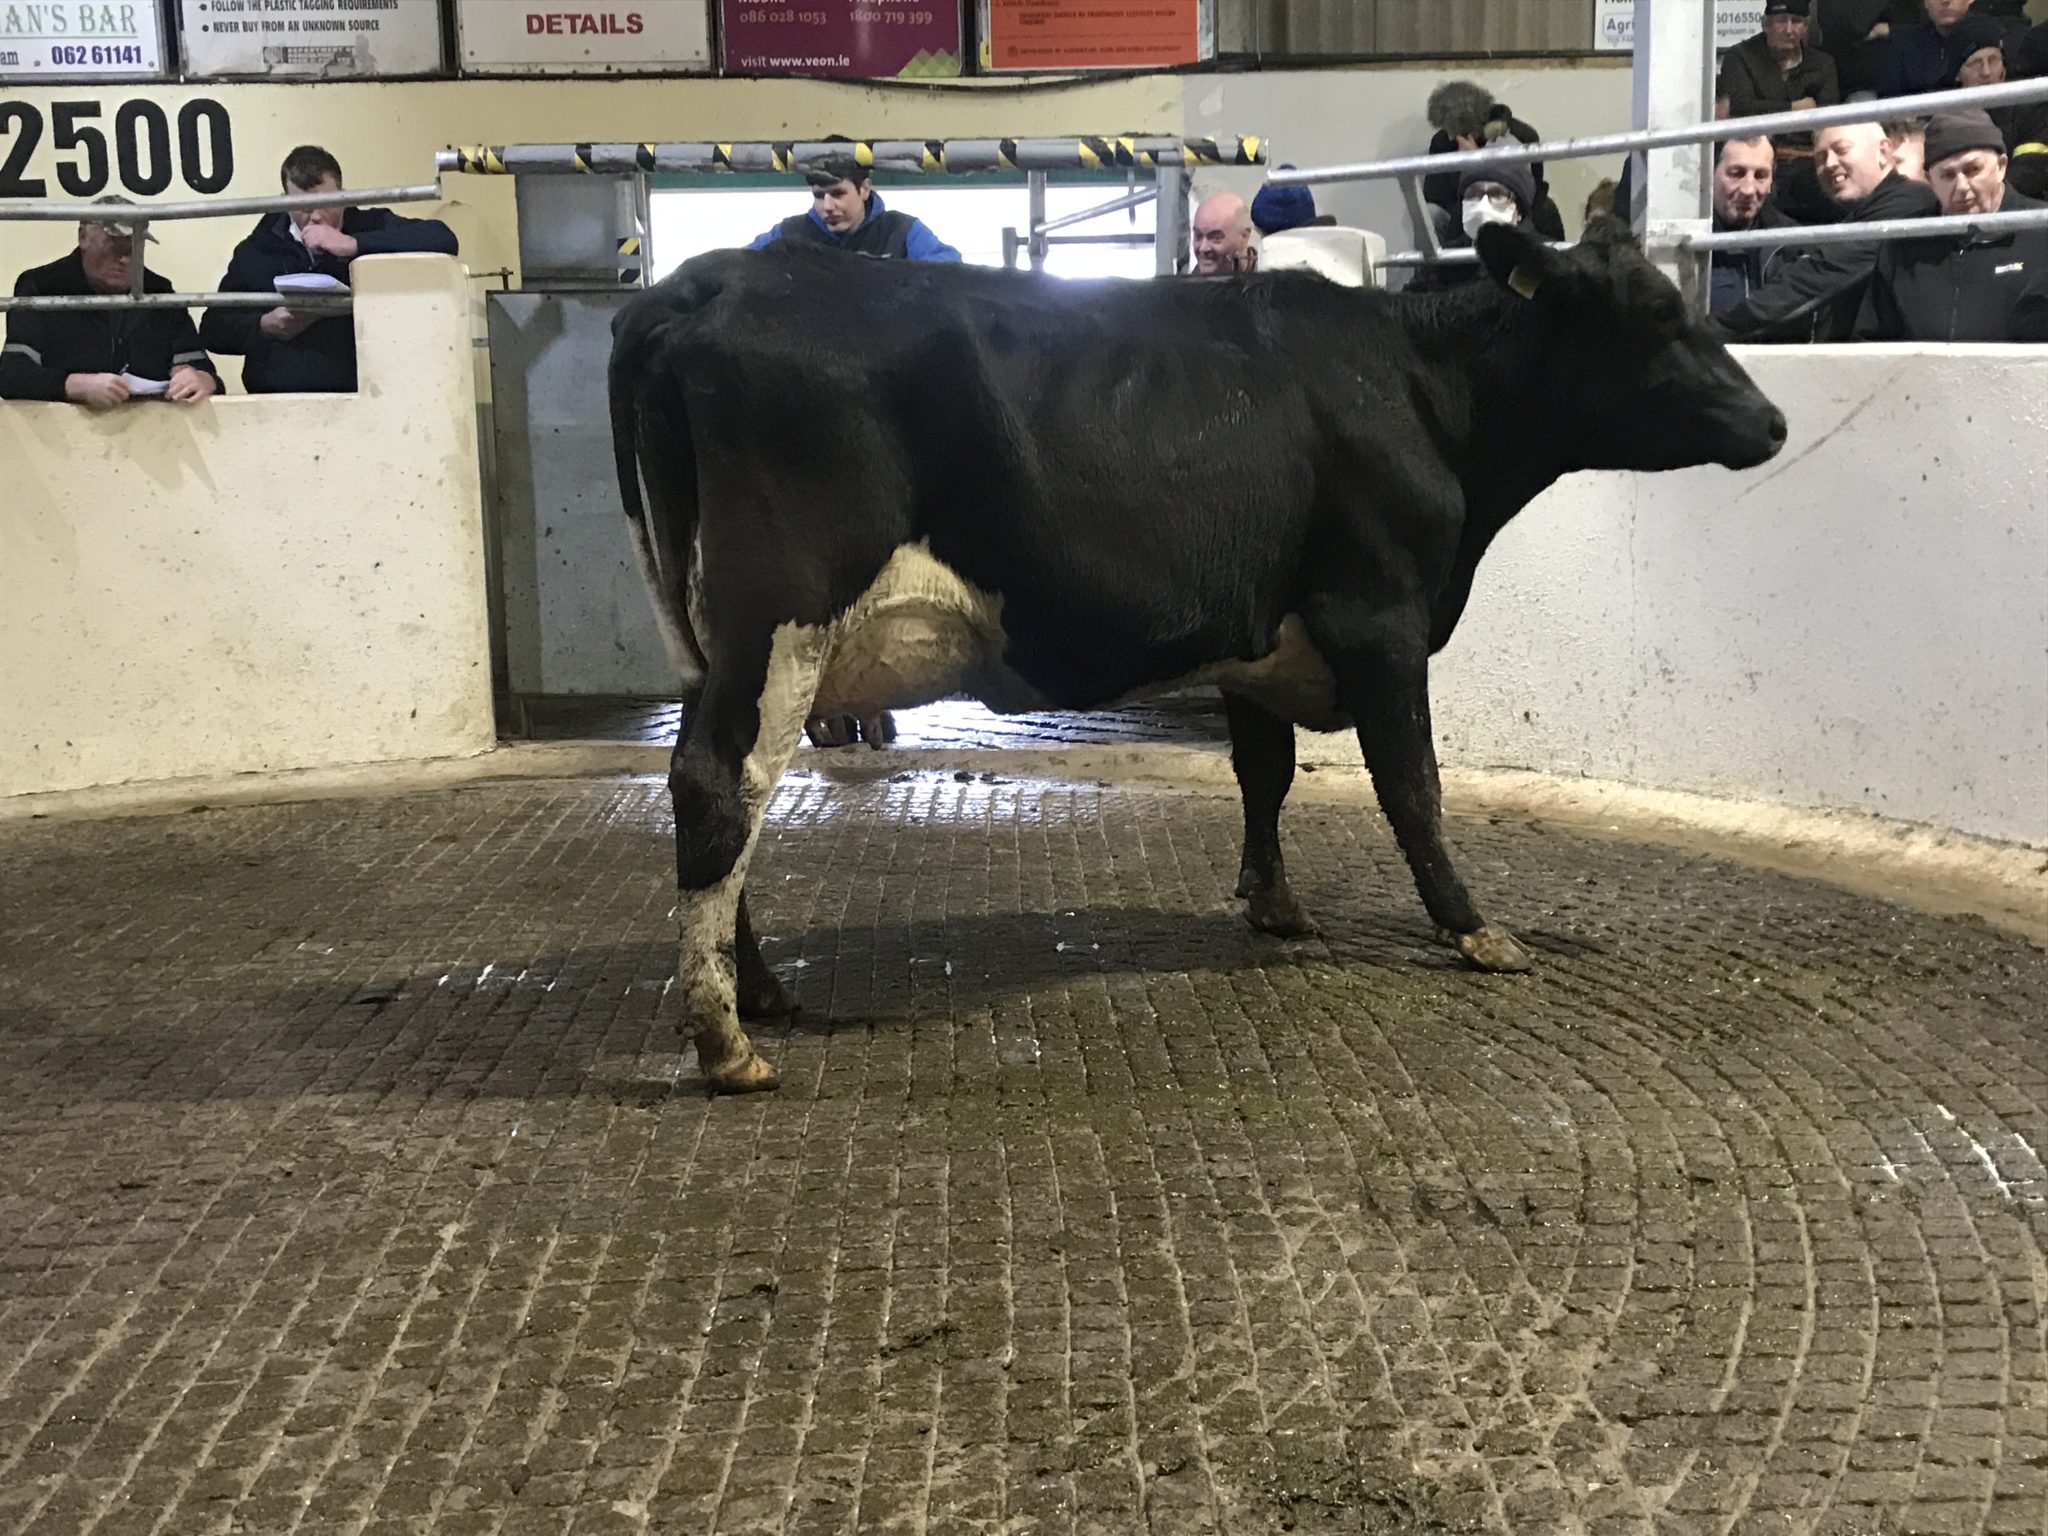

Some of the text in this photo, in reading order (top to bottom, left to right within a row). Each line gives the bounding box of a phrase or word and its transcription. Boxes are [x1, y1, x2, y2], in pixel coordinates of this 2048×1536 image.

[211, 0, 398, 11] FOLLOW THE PLASTIC TAGGING REQUIREMENTS
[79, 4, 137, 34] BAR
[526, 13, 644, 35] DETAILS
[740, 9, 827, 25] 086 028 1053
[849, 8, 933, 25] 1800 719 399
[213, 20, 380, 32] NEVER BUY FROM AN UNKNOWN SOURCE
[51, 45, 87, 65] 062
[91, 45, 142, 64] 61141
[741, 54, 850, 67] visit www.veon.ie
[0, 98, 234, 198] 2500
